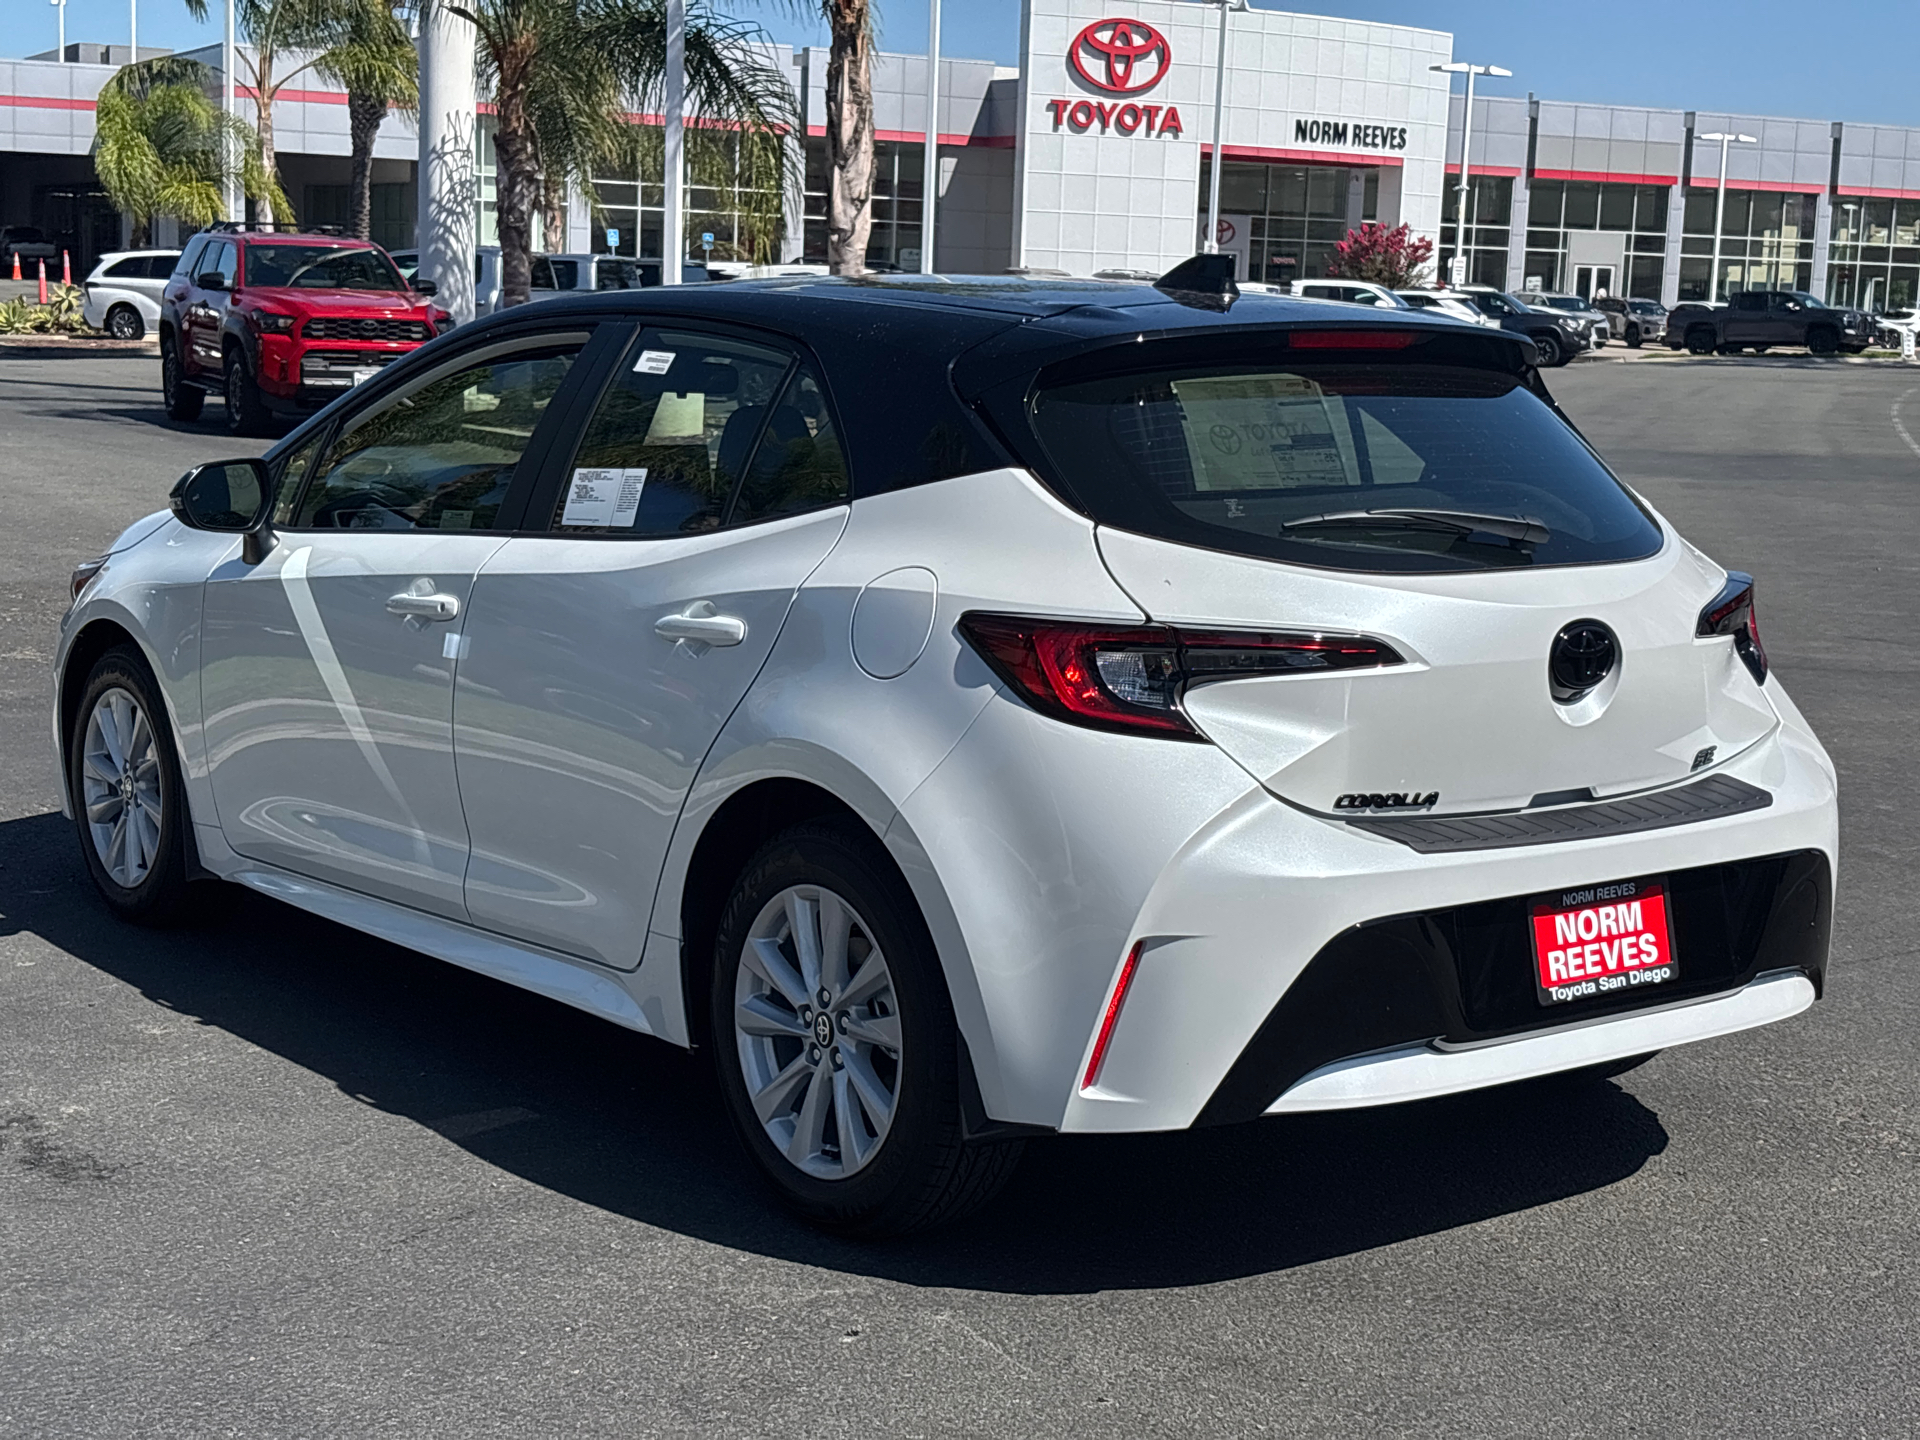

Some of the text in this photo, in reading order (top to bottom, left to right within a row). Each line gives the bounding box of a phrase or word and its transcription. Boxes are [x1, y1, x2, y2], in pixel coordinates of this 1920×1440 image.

[1050, 99, 1183, 133] TOYOTA
[1294, 119, 1407, 150] NORM REEVES
[1240, 422, 1312, 440] TOYOTA
[1333, 791, 1440, 809] COROLLA
[1562, 883, 1635, 906] NORM REEVES
[1554, 901, 1643, 945] NORM
[1547, 933, 1659, 982] REEVES
[1549, 967, 1671, 1001] Toyota San Diego
